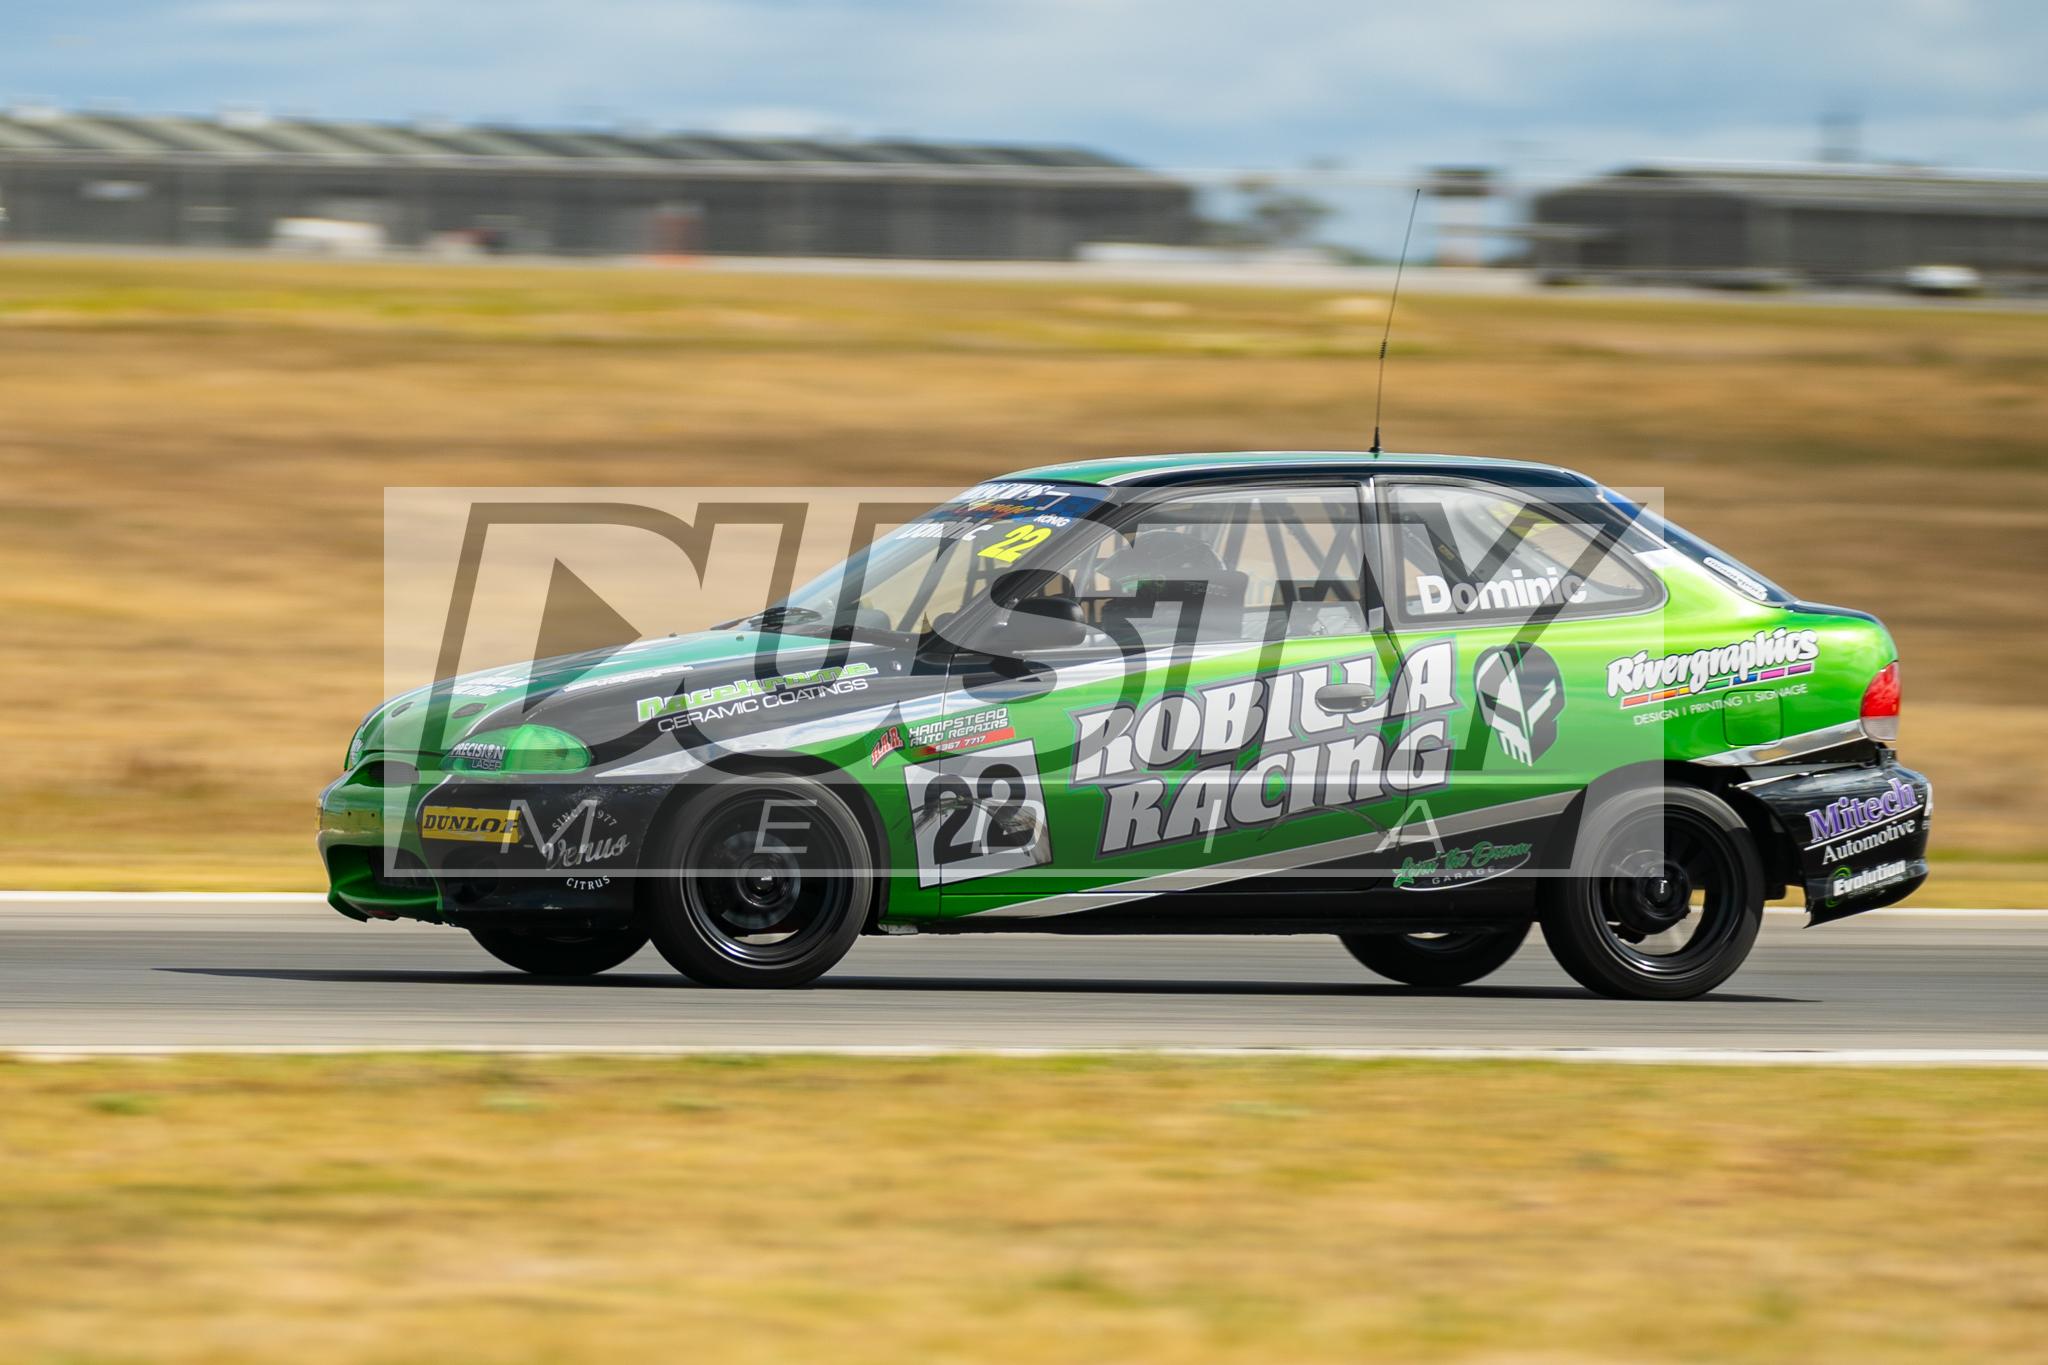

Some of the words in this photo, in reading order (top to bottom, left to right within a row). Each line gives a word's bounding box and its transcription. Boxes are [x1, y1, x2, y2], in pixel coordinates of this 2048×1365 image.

[977, 524, 1052, 563] 22
[1416, 567, 1588, 614] Dominic
[1607, 627, 1820, 698] Rivergraphics
[658, 699, 760, 733] CERAMIC
[763, 678, 869, 709] COATINGS
[908, 707, 1008, 738] HAMPSTEAD
[1634, 708, 1680, 726] DESIGN
[1690, 695, 1743, 715] PRINTING
[1755, 683, 1809, 702] SIGNAGE
[451, 742, 506, 760] PRECISION
[910, 732, 944, 747] AUTO
[948, 717, 1009, 739] REPAIRS
[471, 759, 502, 770] LASER
[1101, 720, 1450, 855] RACING
[1805, 777, 1919, 844] Mitech
[1822, 818, 1916, 866] Automotive
[566, 875, 611, 890] CITRUS
[1431, 865, 1496, 885] GARAGE
[1833, 860, 1906, 897] Evolution
